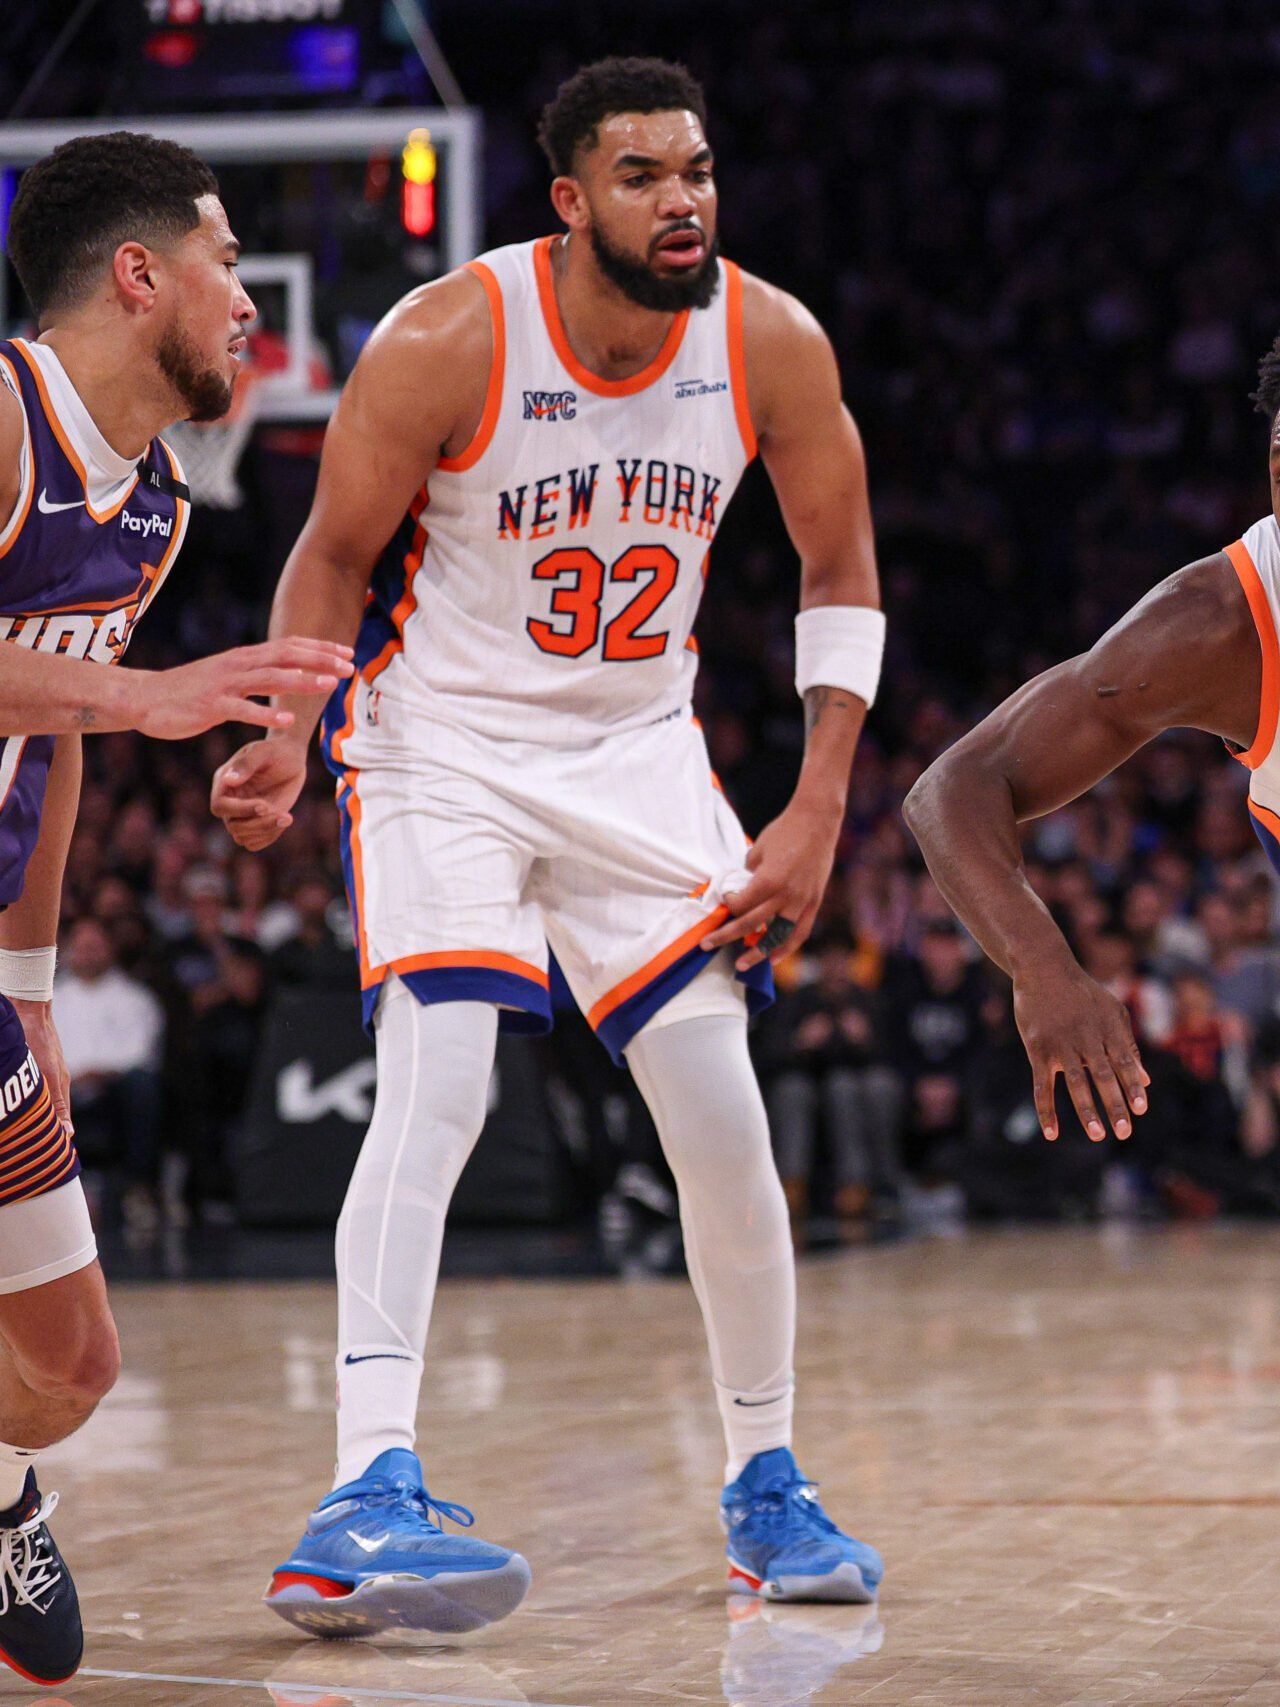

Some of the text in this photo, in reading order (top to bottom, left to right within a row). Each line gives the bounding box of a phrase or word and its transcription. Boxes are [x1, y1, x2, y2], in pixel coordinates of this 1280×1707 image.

[523, 391, 577, 421] NYC
[150, 471, 161, 488] AL
[497, 459, 722, 541] NEW YORK
[121, 509, 173, 538] PayPal
[526, 544, 680, 662] 32
